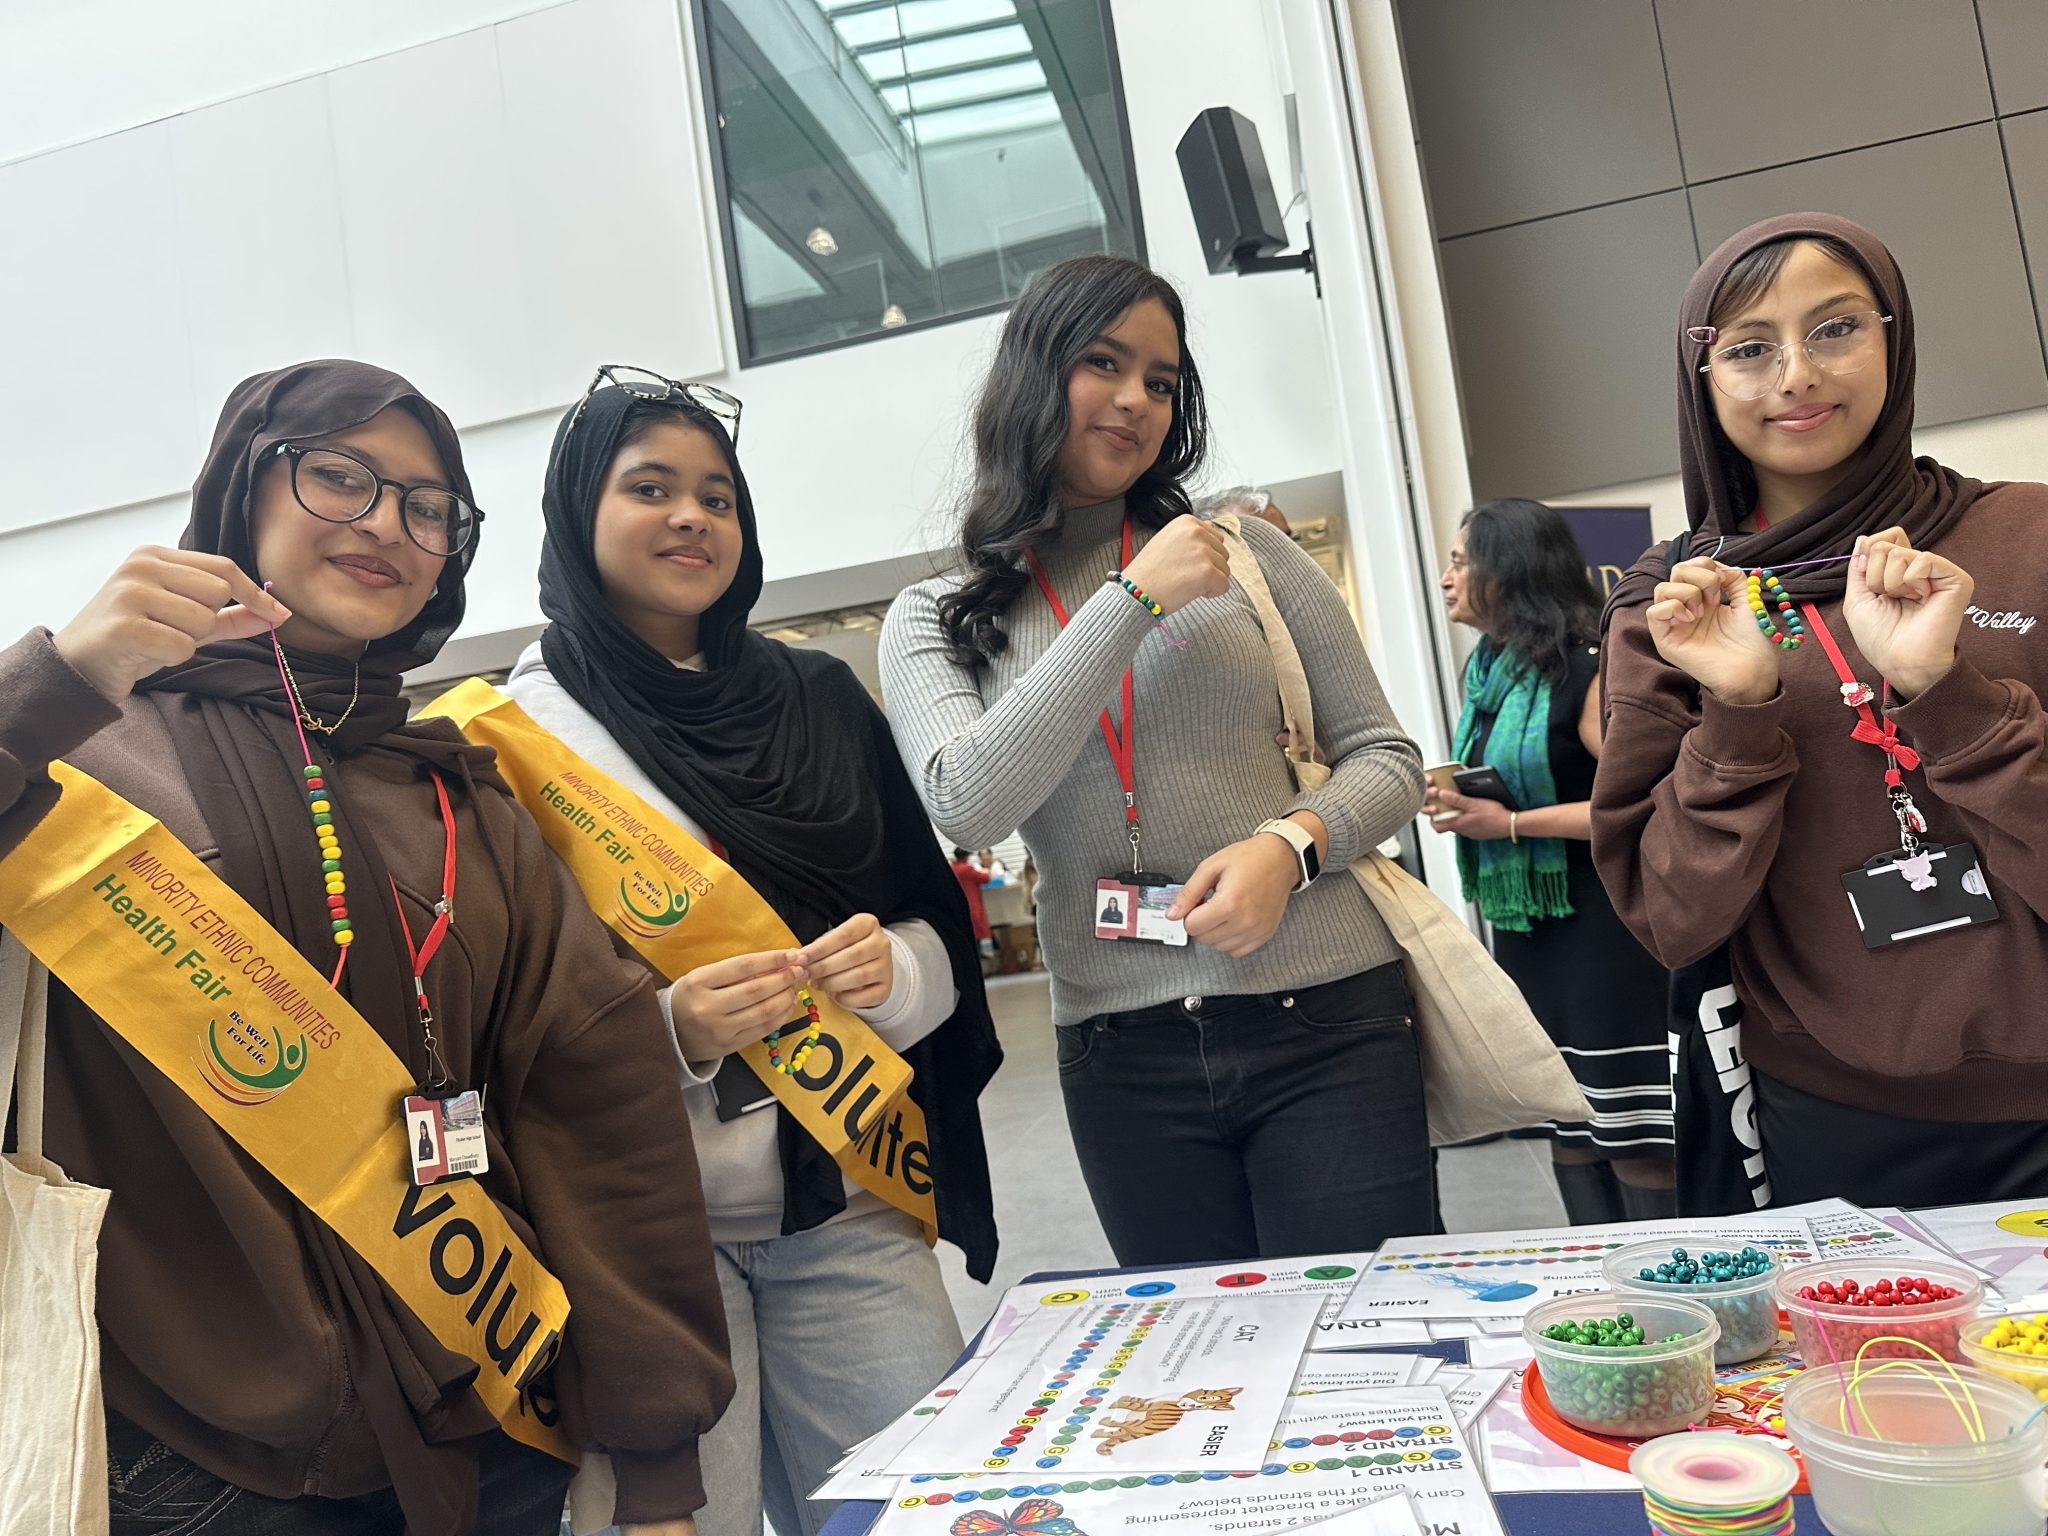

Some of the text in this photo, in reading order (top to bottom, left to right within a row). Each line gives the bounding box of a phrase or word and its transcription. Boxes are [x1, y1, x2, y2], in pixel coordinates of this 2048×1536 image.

[1972, 611, 2036, 634] Valley
[540, 781, 635, 864] Health Fair
[560, 771, 714, 897] MINORITY ETHNIC COMMUNITIES
[633, 870, 663, 897] Be Well
[632, 882, 662, 910] For Life
[93, 873, 232, 1001] Health Fair
[126, 849, 340, 1050] MINORITY ETHNIC COMMUNITIES
[228, 1010, 269, 1048] Be Well
[226, 1026, 267, 1066] For Life
[1829, 1238, 1902, 1250] STRAND
[1316, 1268, 1342, 1278] A
[1229, 1276, 1253, 1285] T
[1136, 1284, 1164, 1294] C
[1052, 1292, 1079, 1303] G
[1316, 1320, 1382, 1331] DNA
[1233, 1324, 1259, 1342] CAT
[1332, 1410, 1365, 1419] taste
[1369, 1406, 1438, 1415] Butterflies
[1300, 1413, 1328, 1423] with
[1338, 1418, 1386, 1428] know?
[1389, 1416, 1414, 1424] you
[1200, 1425, 1228, 1456] EASIER
[1363, 1436, 1453, 1450] STRAND
[1352, 1461, 1463, 1477] STRAND 1
[1179, 1483, 1406, 1510] one of the strands below?
[1427, 1489, 1465, 1498] Can
[1241, 1502, 1315, 1514] bracelet
[1125, 1509, 1236, 1524] representing
[1287, 1517, 1298, 1526] 2
[1209, 1518, 1281, 1531] strands.
